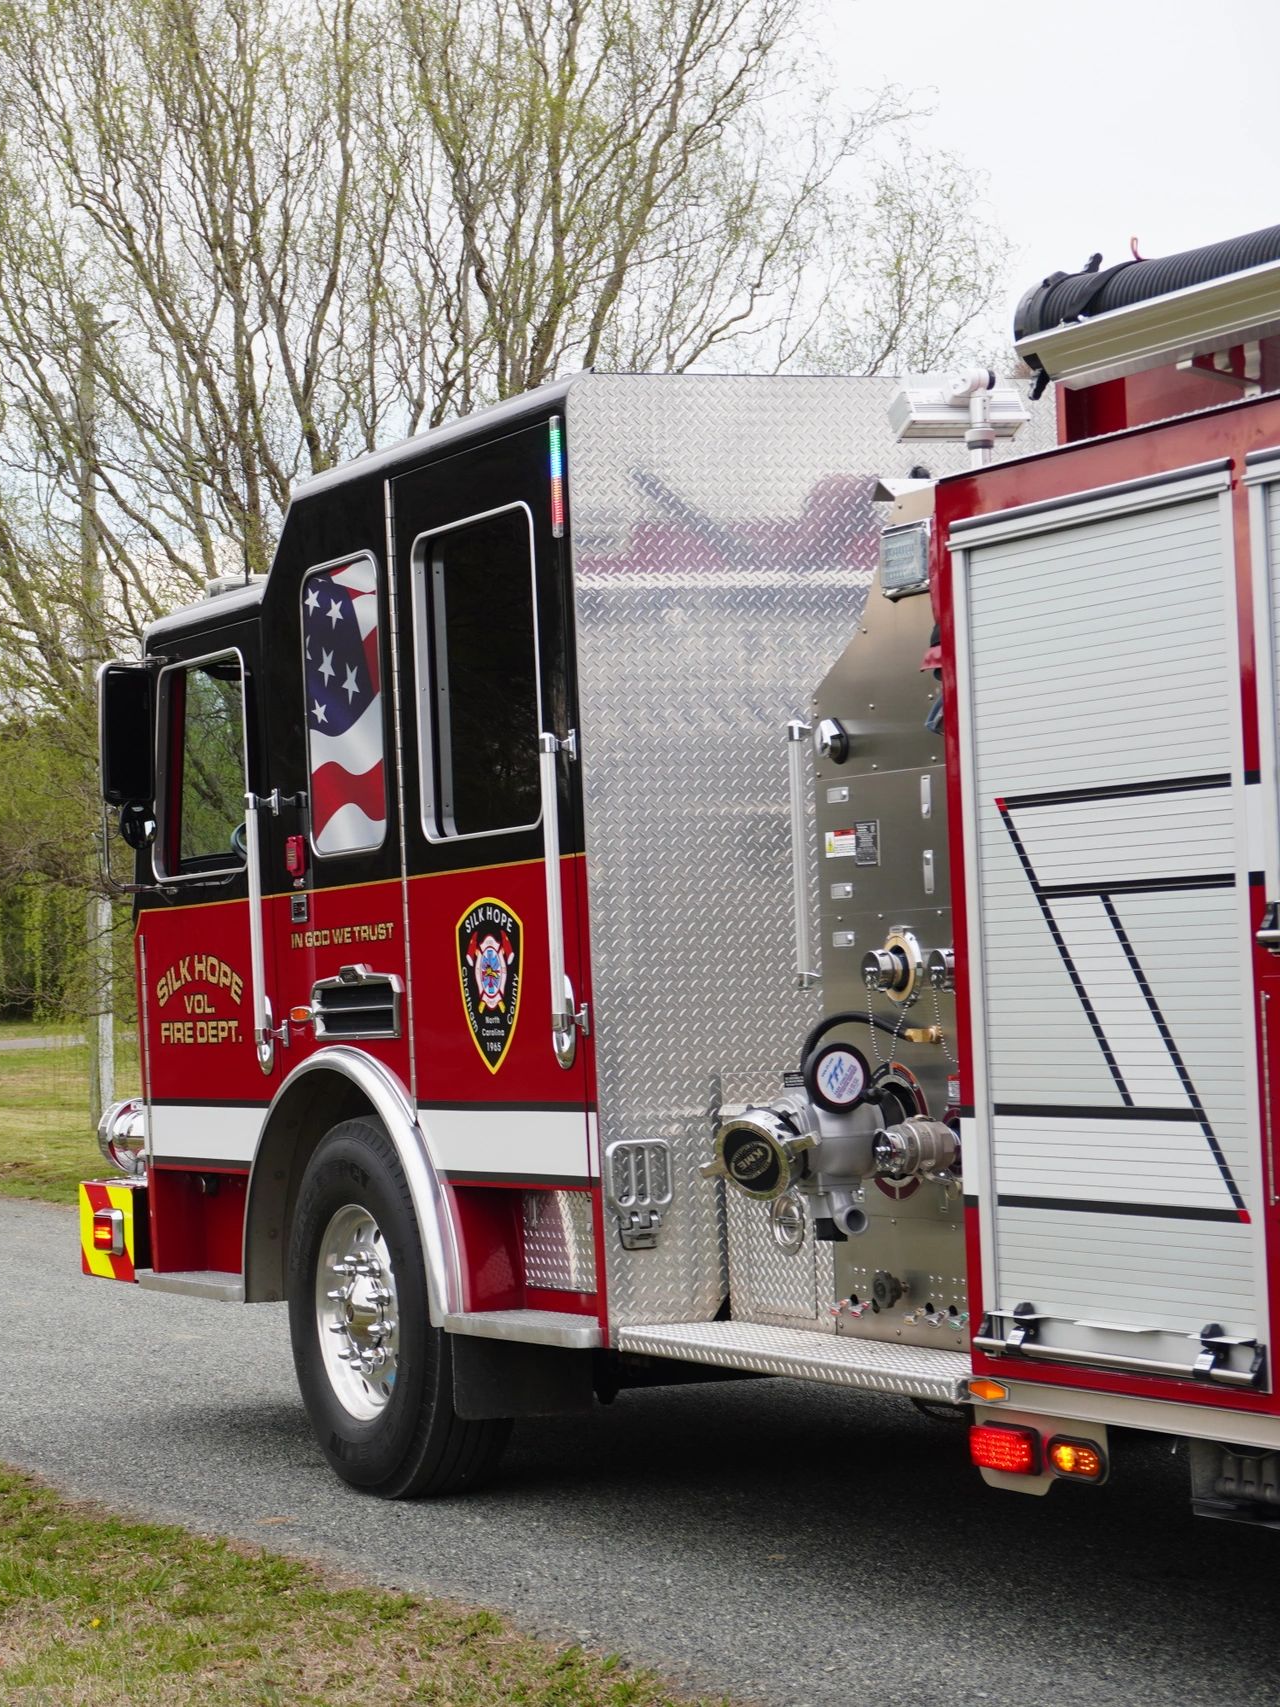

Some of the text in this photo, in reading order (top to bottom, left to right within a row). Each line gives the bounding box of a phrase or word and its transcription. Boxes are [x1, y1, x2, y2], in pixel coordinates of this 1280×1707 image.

[464, 906, 513, 933] SILK HOPE
[291, 922, 394, 949] IN GOD WE TRUST
[156, 954, 244, 1008] SILK HOPE
[183, 994, 216, 1015] VOL.
[461, 966, 479, 1033] Chatham
[506, 973, 520, 1025] County
[161, 1020, 243, 1044] FIRE DEPT.
[481, 1028, 506, 1037] Carolina
[485, 1016, 501, 1024] North
[486, 1041, 502, 1052] 1965
